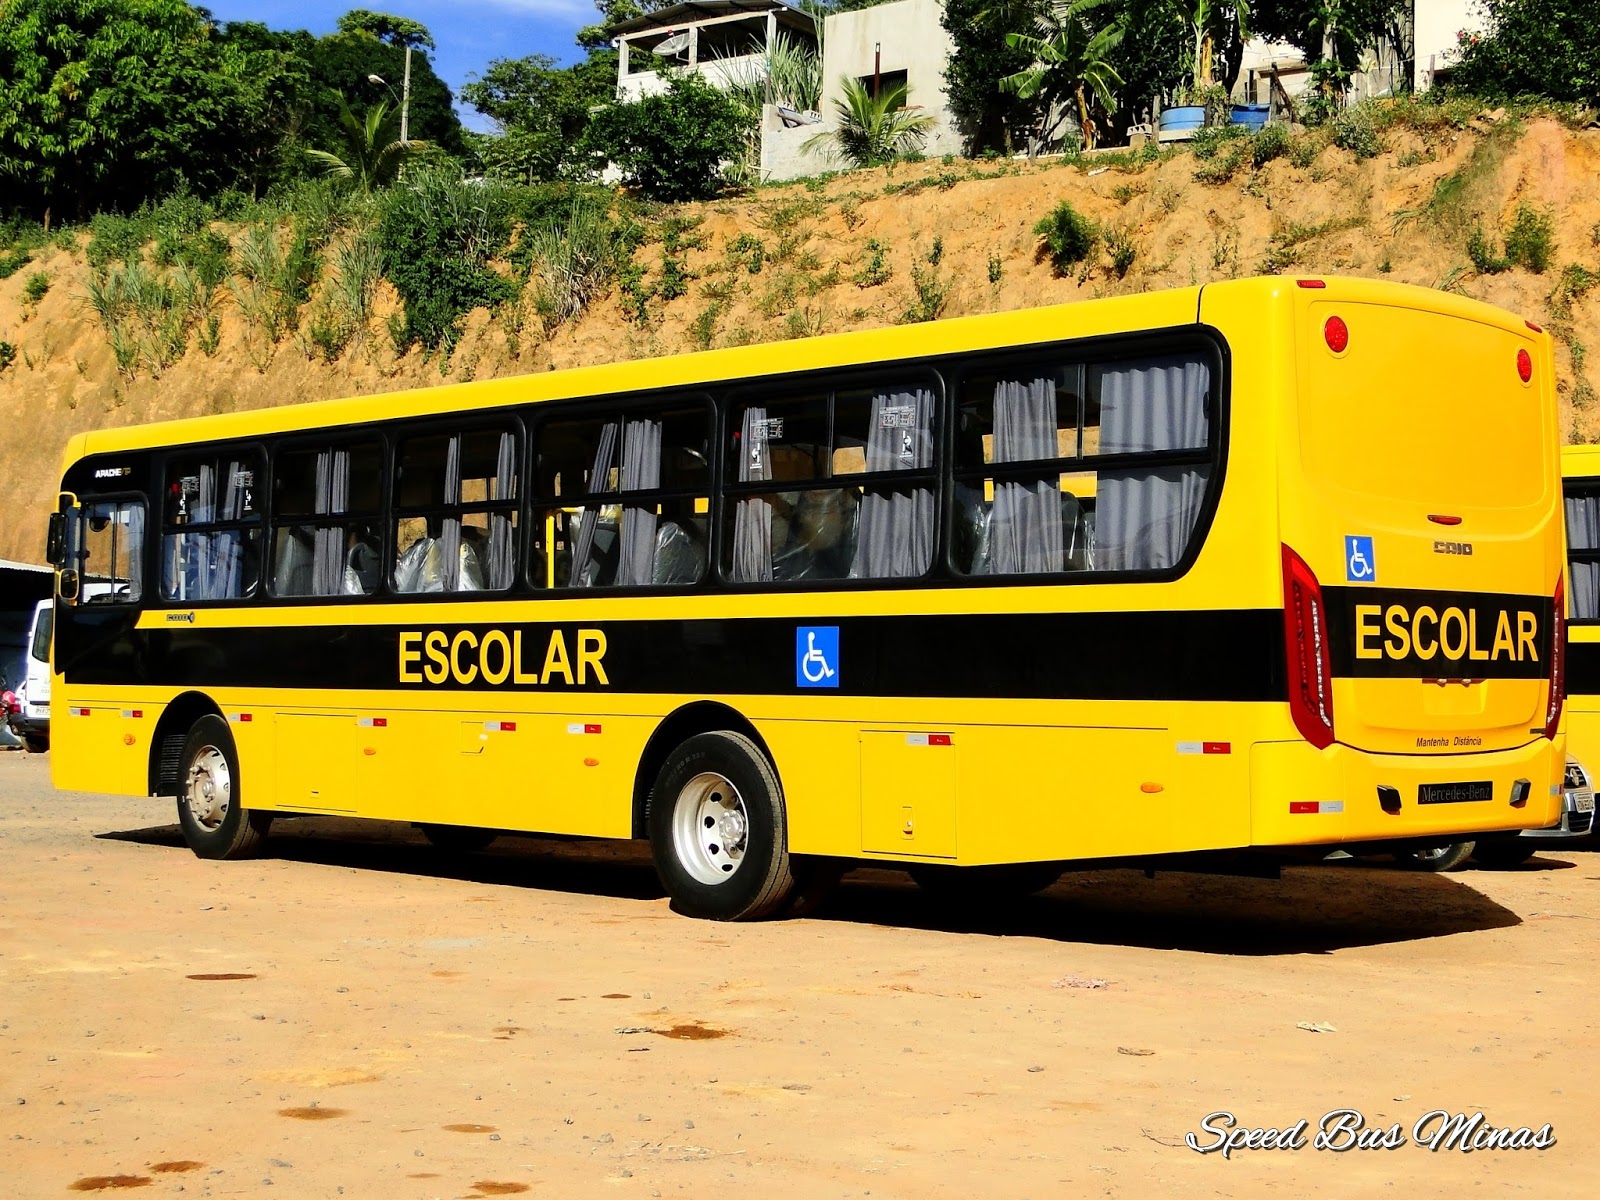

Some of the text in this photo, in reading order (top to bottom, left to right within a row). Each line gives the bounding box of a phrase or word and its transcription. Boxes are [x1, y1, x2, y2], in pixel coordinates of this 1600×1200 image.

[1433, 541, 1473, 556] CAIO
[1355, 604, 1539, 662] ESCOLAR
[399, 629, 609, 685] ESCOLAR
[1416, 736, 1482, 747] Mantenha Distância
[1422, 784, 1490, 802] Mercedes-Benz
